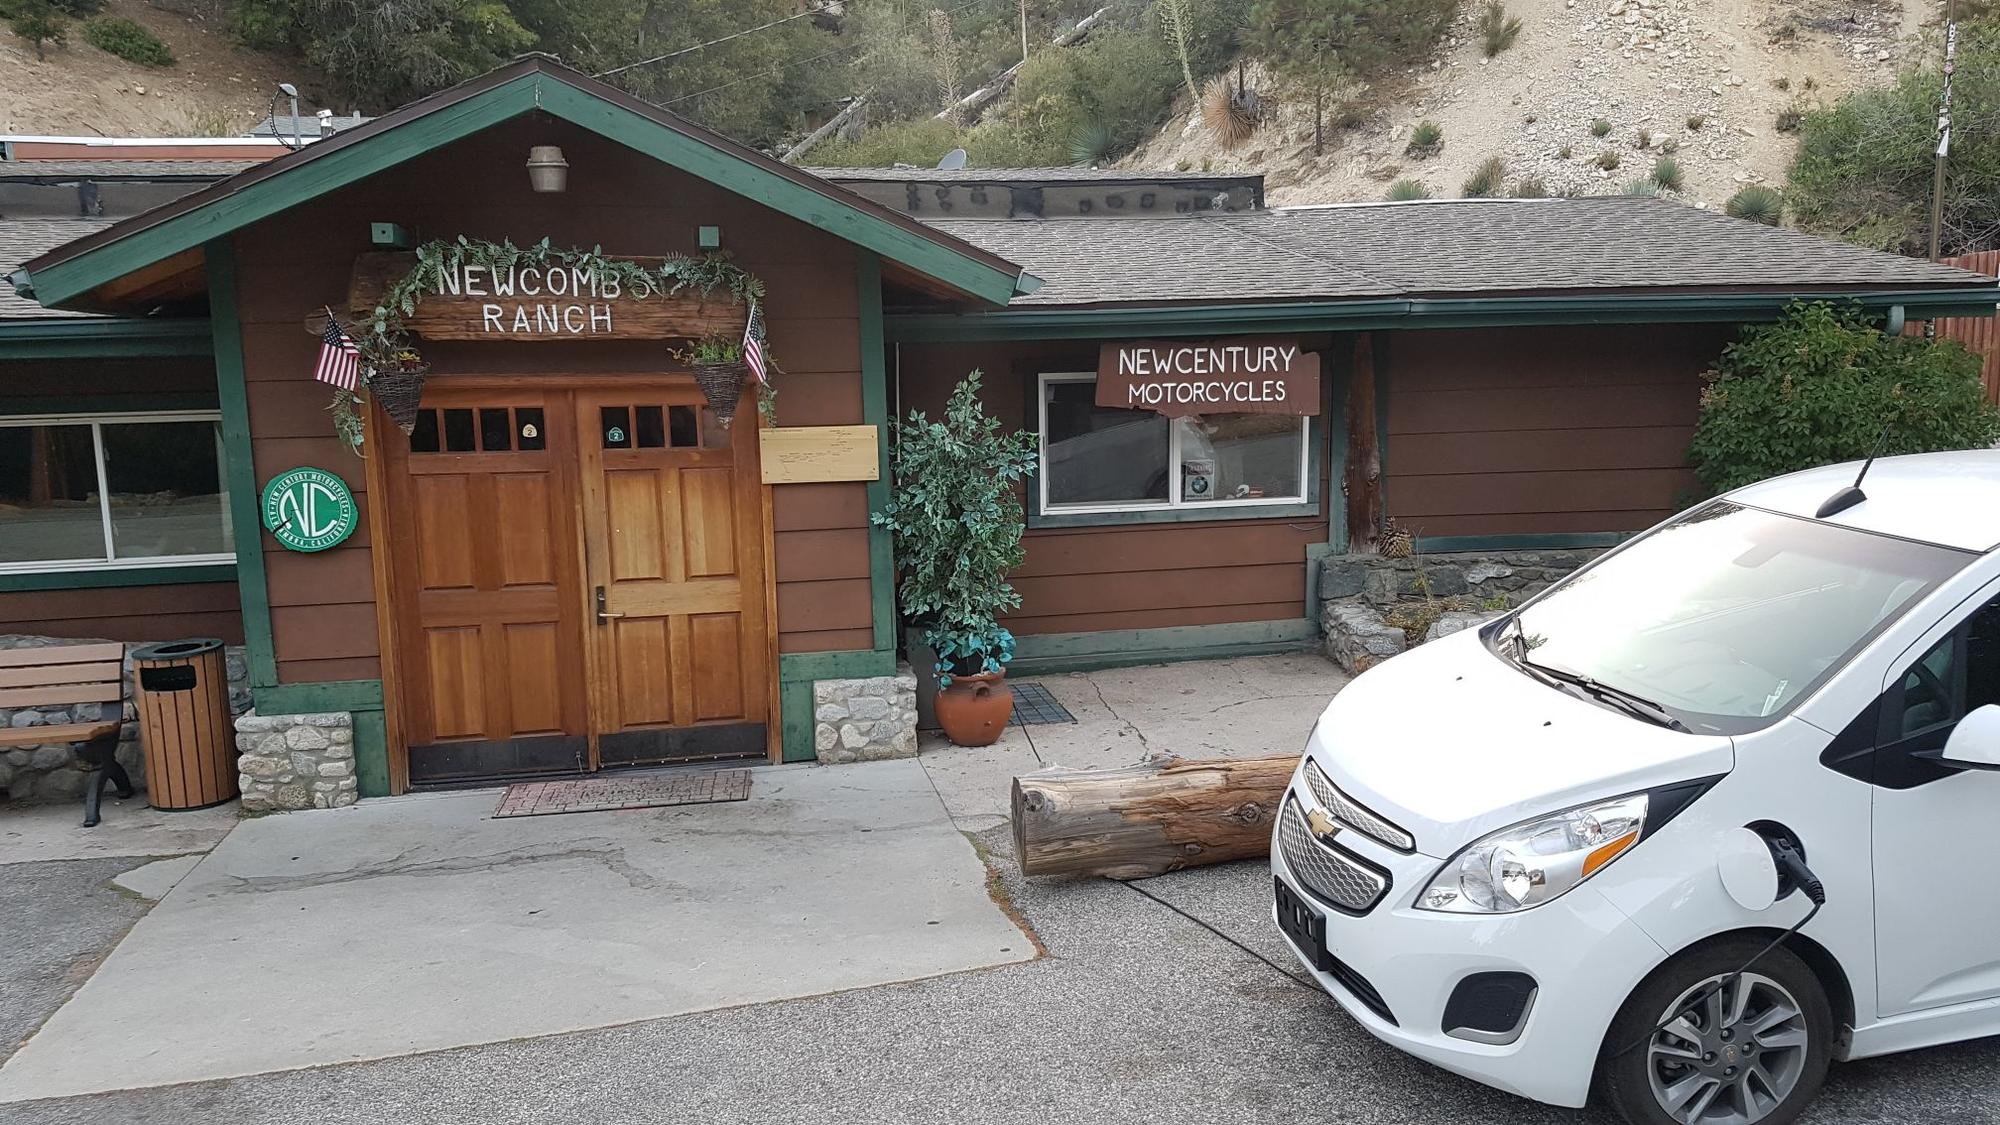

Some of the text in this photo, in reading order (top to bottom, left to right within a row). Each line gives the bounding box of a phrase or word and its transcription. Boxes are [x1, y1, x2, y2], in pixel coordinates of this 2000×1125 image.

[483, 304, 613, 333] RANCH
[1128, 380, 1286, 404] MOTORCYCLES
[269, 491, 280, 506] NEW
[279, 473, 308, 490] CENTURY
[280, 482, 337, 537] NC
